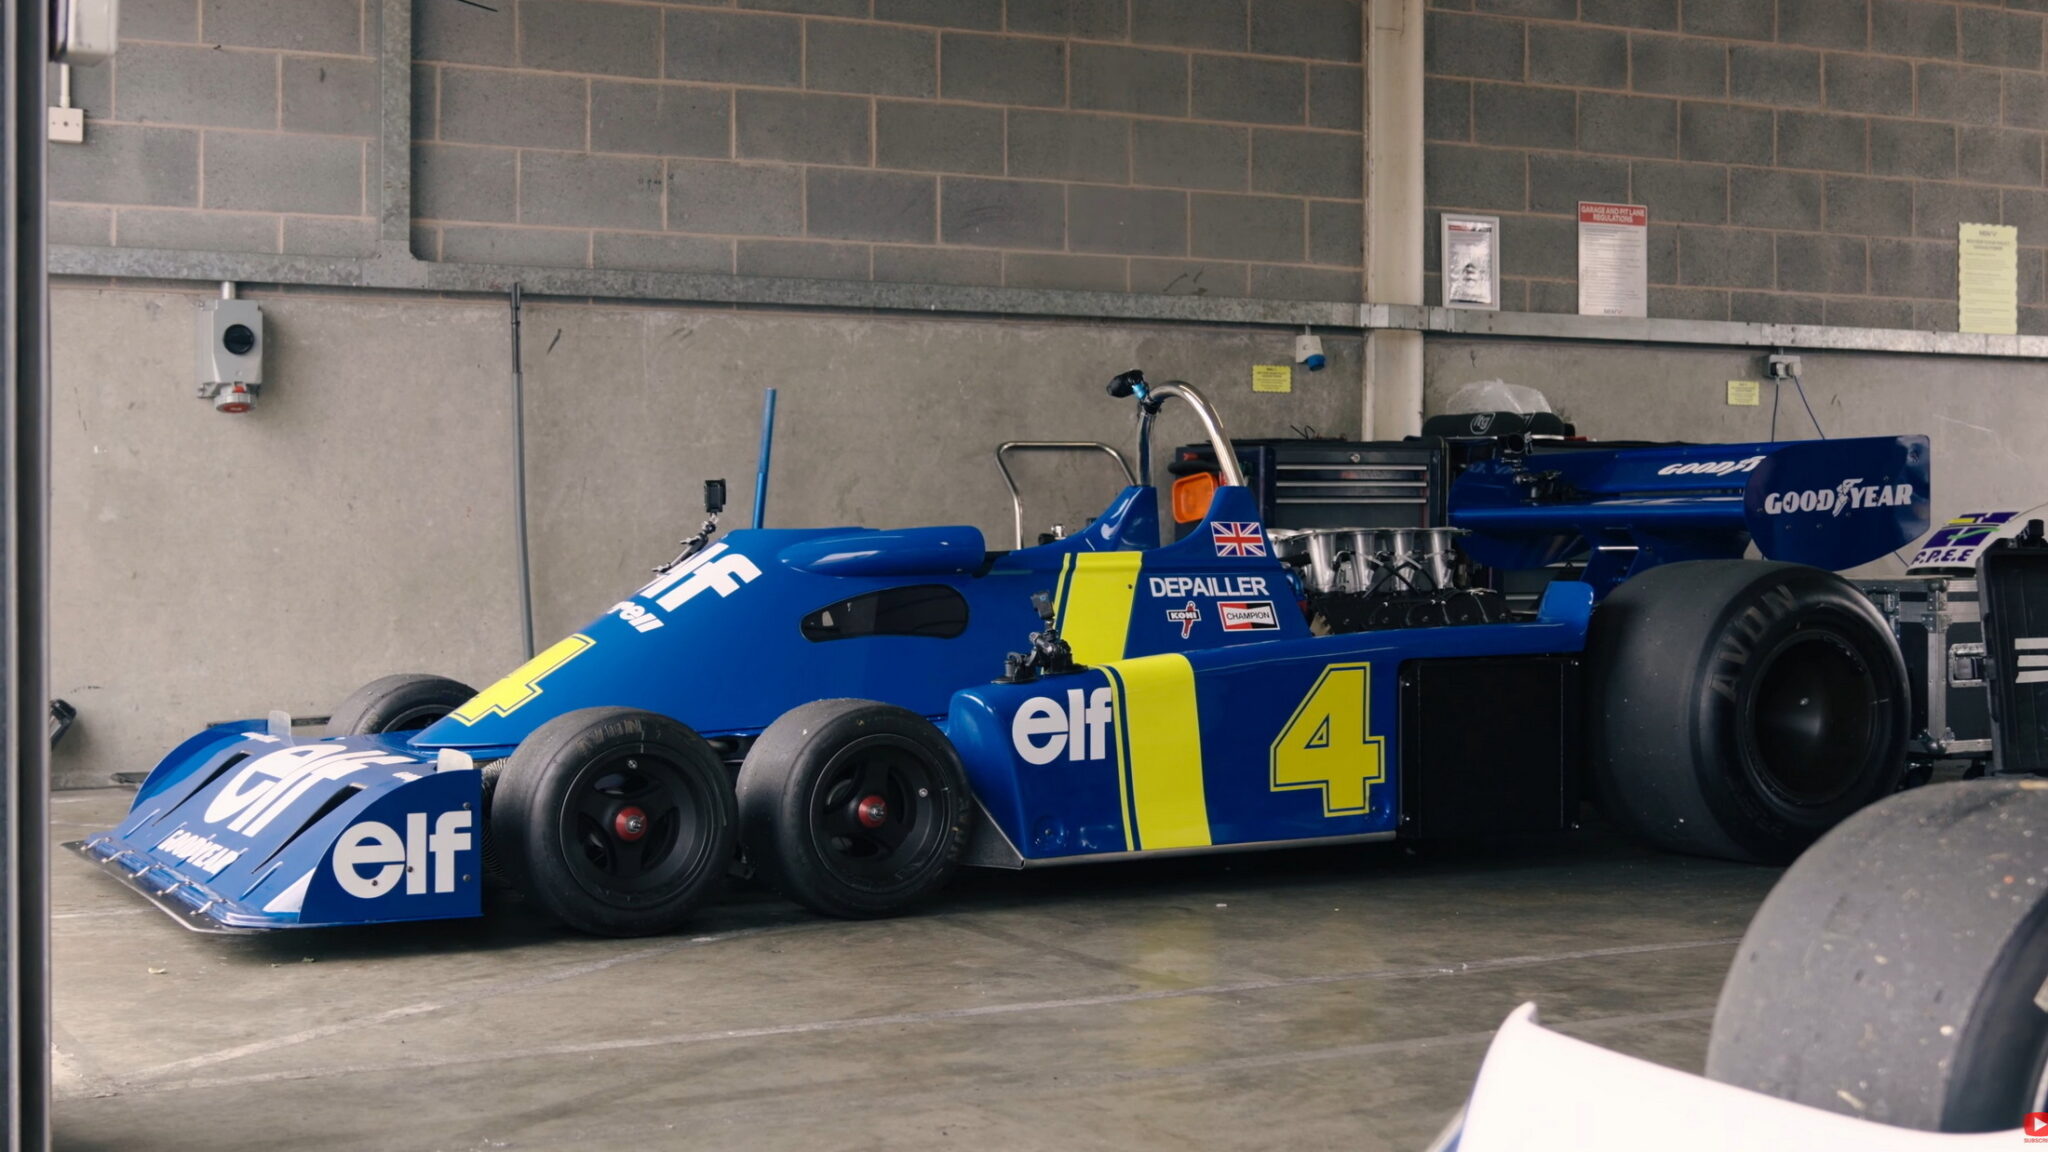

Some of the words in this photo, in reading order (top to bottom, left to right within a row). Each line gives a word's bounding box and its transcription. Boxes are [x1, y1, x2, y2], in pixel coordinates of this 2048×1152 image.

[636, 542, 763, 612] lf
[1149, 577, 1270, 597] DEPAILLER
[1170, 611, 1198, 620] KONI
[1226, 612, 1270, 621] CHAMPION
[1012, 687, 1113, 765] elf
[1270, 661, 1385, 818] 4
[204, 744, 418, 838] elf
[332, 810, 472, 899] elf
